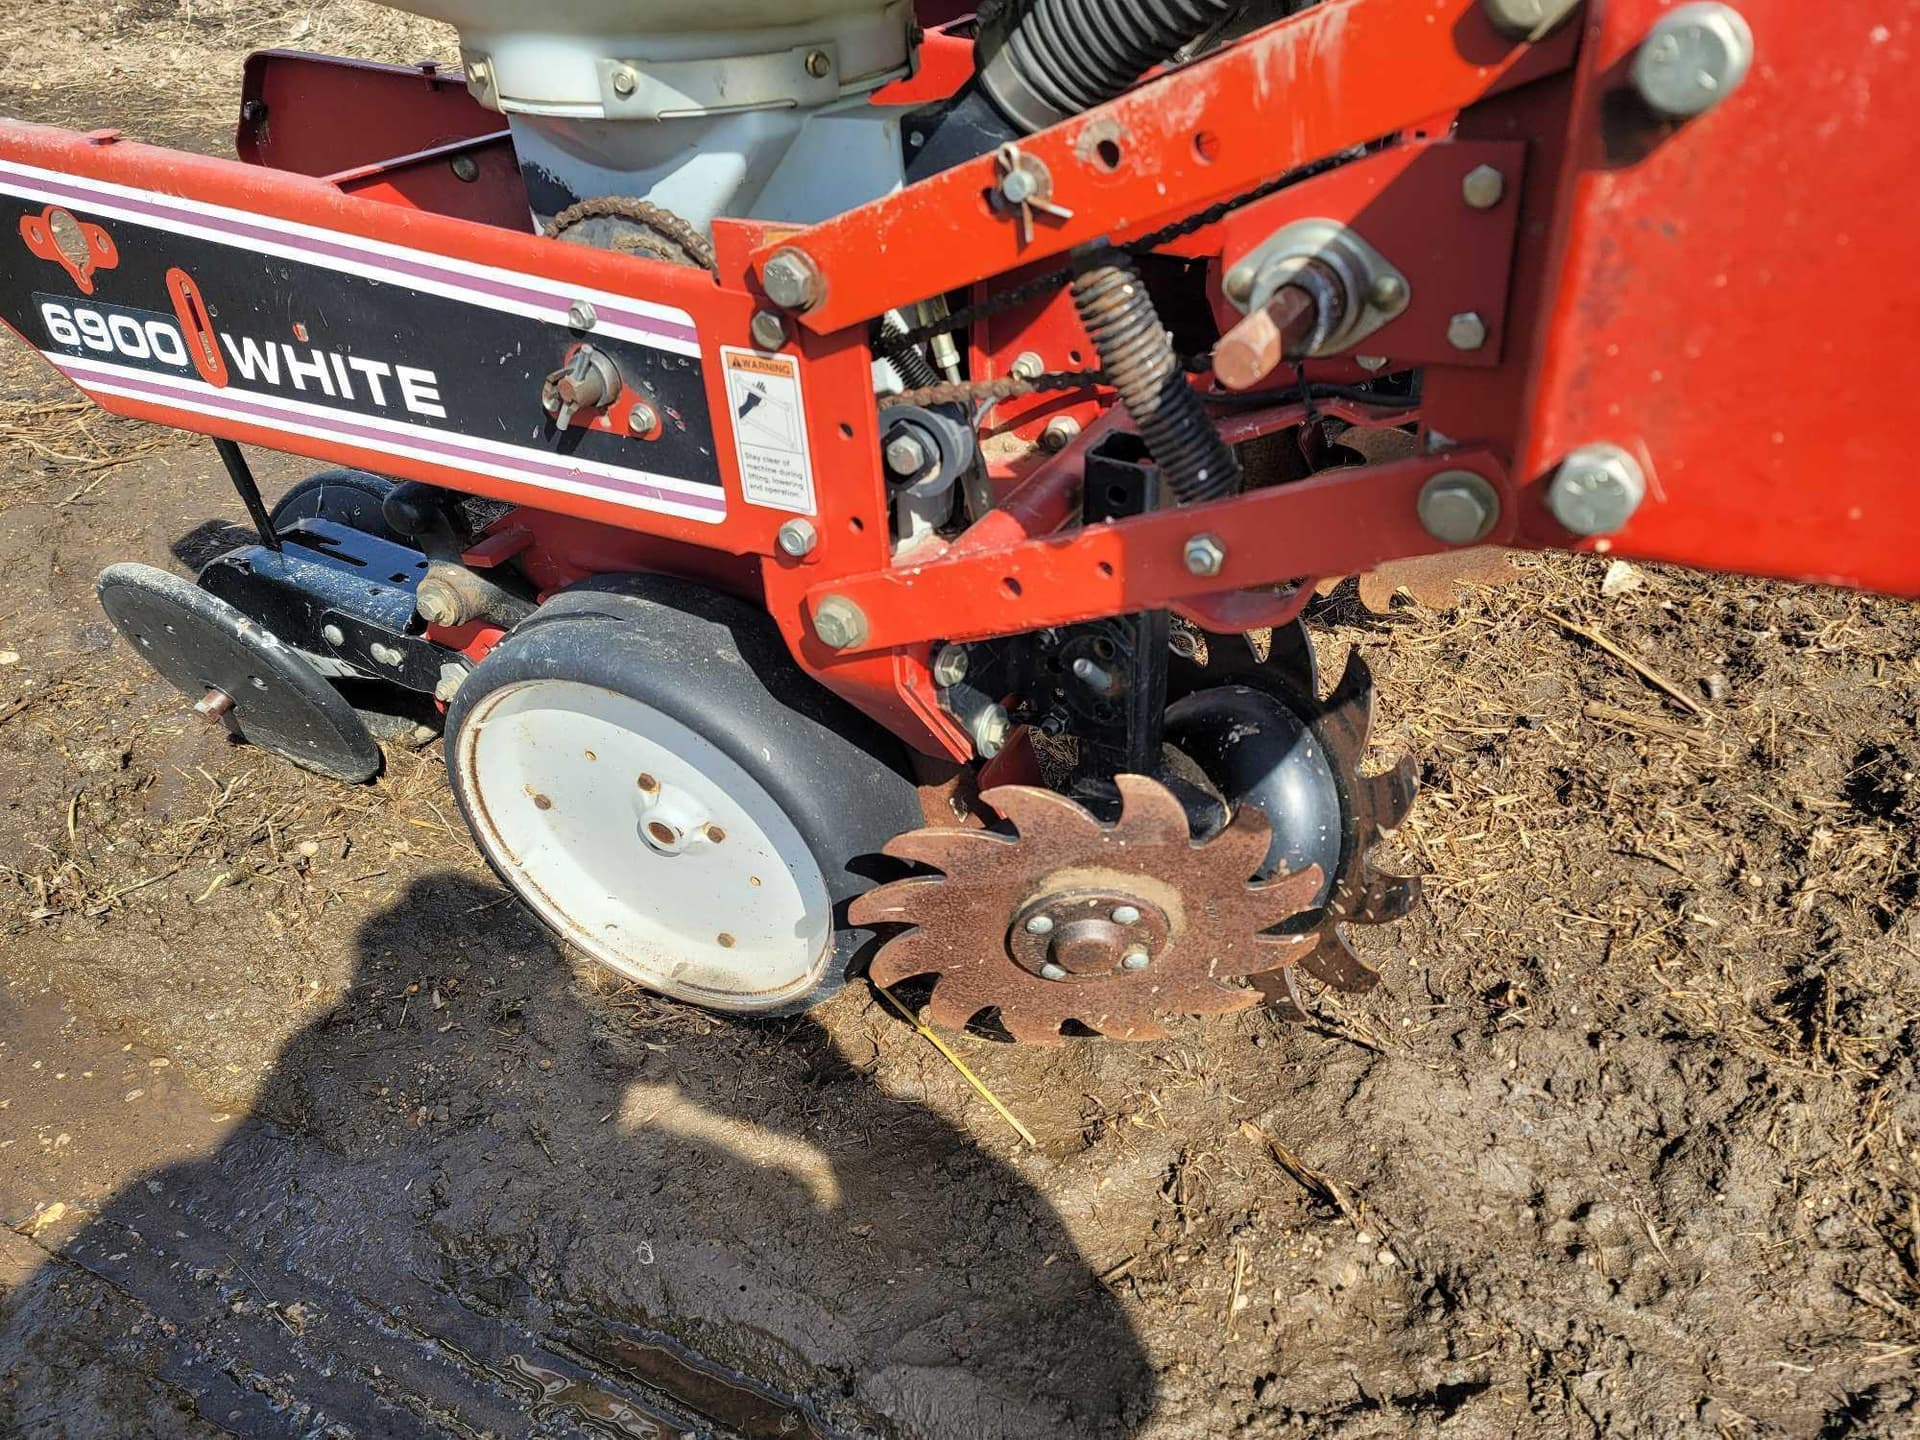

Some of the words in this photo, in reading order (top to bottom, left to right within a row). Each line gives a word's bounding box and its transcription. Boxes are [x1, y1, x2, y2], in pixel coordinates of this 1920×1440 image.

[41, 302, 189, 367] 6900
[741, 359, 791, 375] WARNING
[220, 332, 447, 419] WHITE
[744, 452, 761, 464] Stay
[762, 456, 780, 465] clear
[782, 459, 790, 467] of
[746, 463, 777, 474] machine
[779, 468, 803, 480] during
[750, 483, 763, 491] and
[772, 477, 804, 490] lowering
